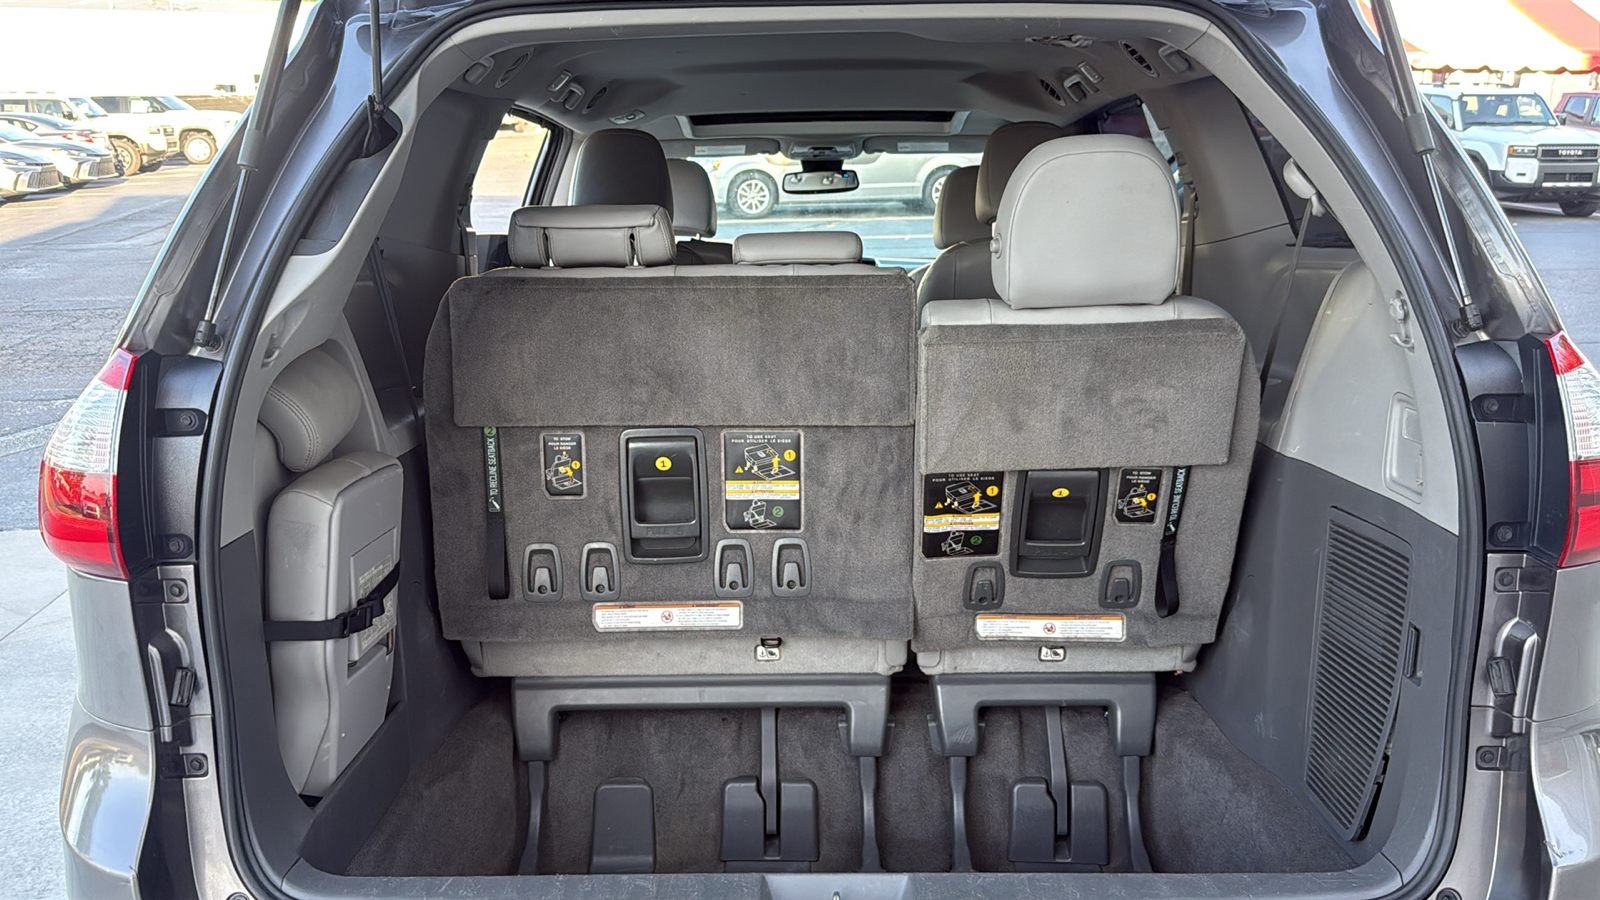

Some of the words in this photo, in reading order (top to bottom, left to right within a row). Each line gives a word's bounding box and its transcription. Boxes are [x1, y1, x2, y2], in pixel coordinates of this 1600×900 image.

[486, 438, 496, 465] SEATBACK
[488, 466, 498, 488] RECLINE
[1174, 468, 1186, 494] SEATBACK
[489, 488, 498, 496] TO
[1170, 494, 1182, 514] RECLINE
